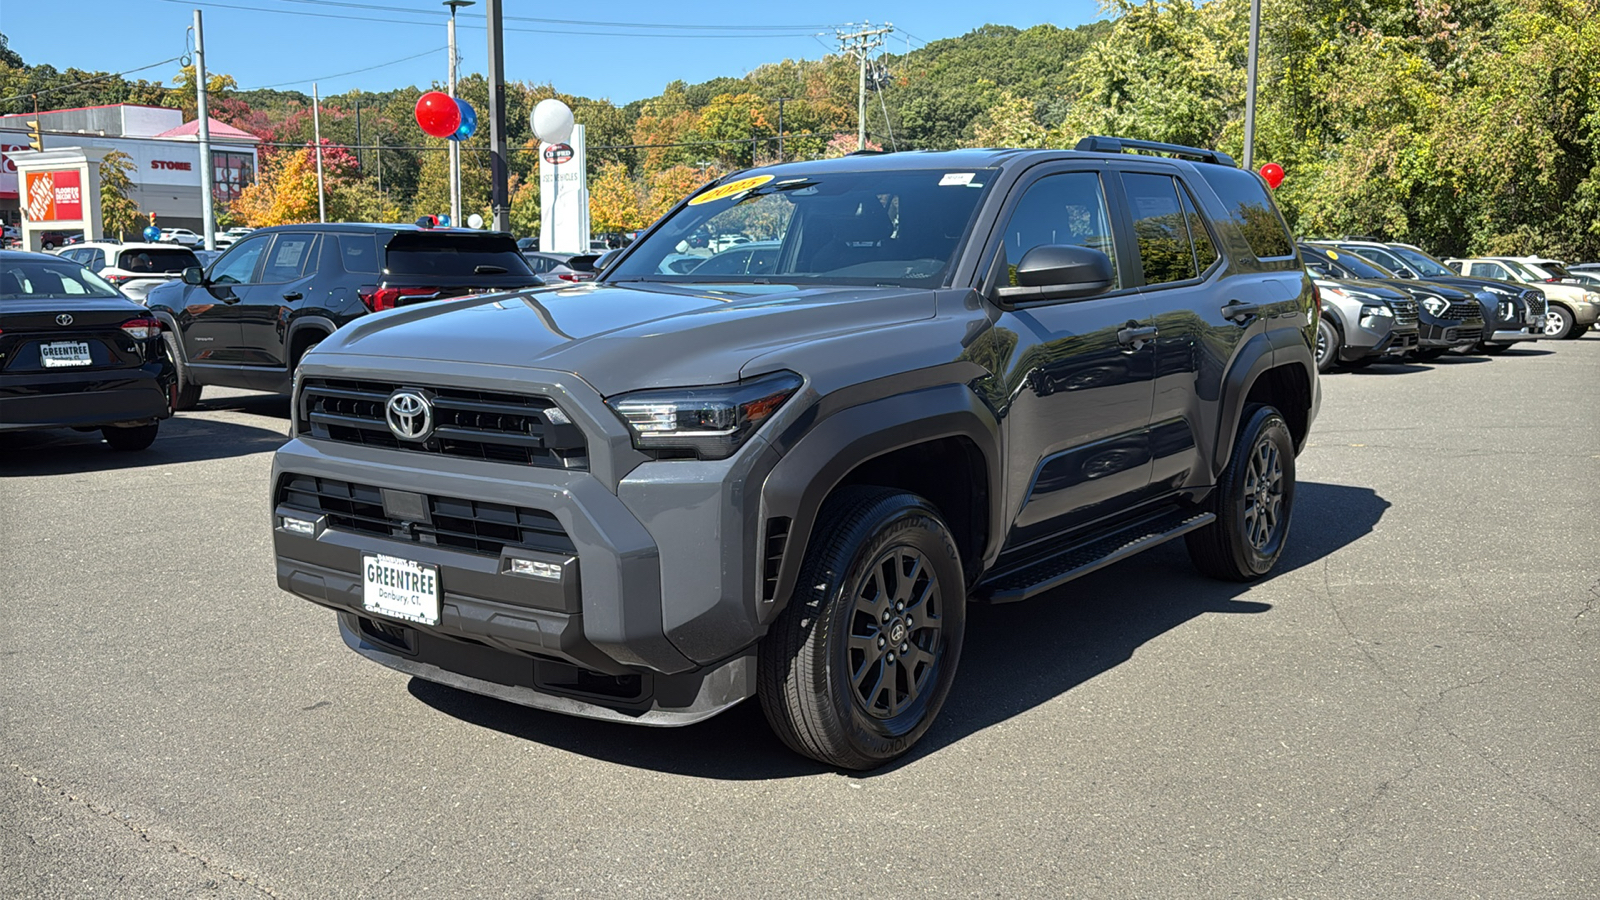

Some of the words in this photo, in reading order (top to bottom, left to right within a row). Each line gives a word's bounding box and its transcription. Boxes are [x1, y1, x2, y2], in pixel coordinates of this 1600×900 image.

[151, 160, 192, 171] STONE
[28, 172, 53, 221] HOME
[42, 346, 88, 356] GREENTREE
[367, 563, 434, 595] GREENTREE
[379, 588, 410, 605] Danbury,
[411, 595, 421, 606] CT.
[365, 605, 434, 625] GREENTREE
